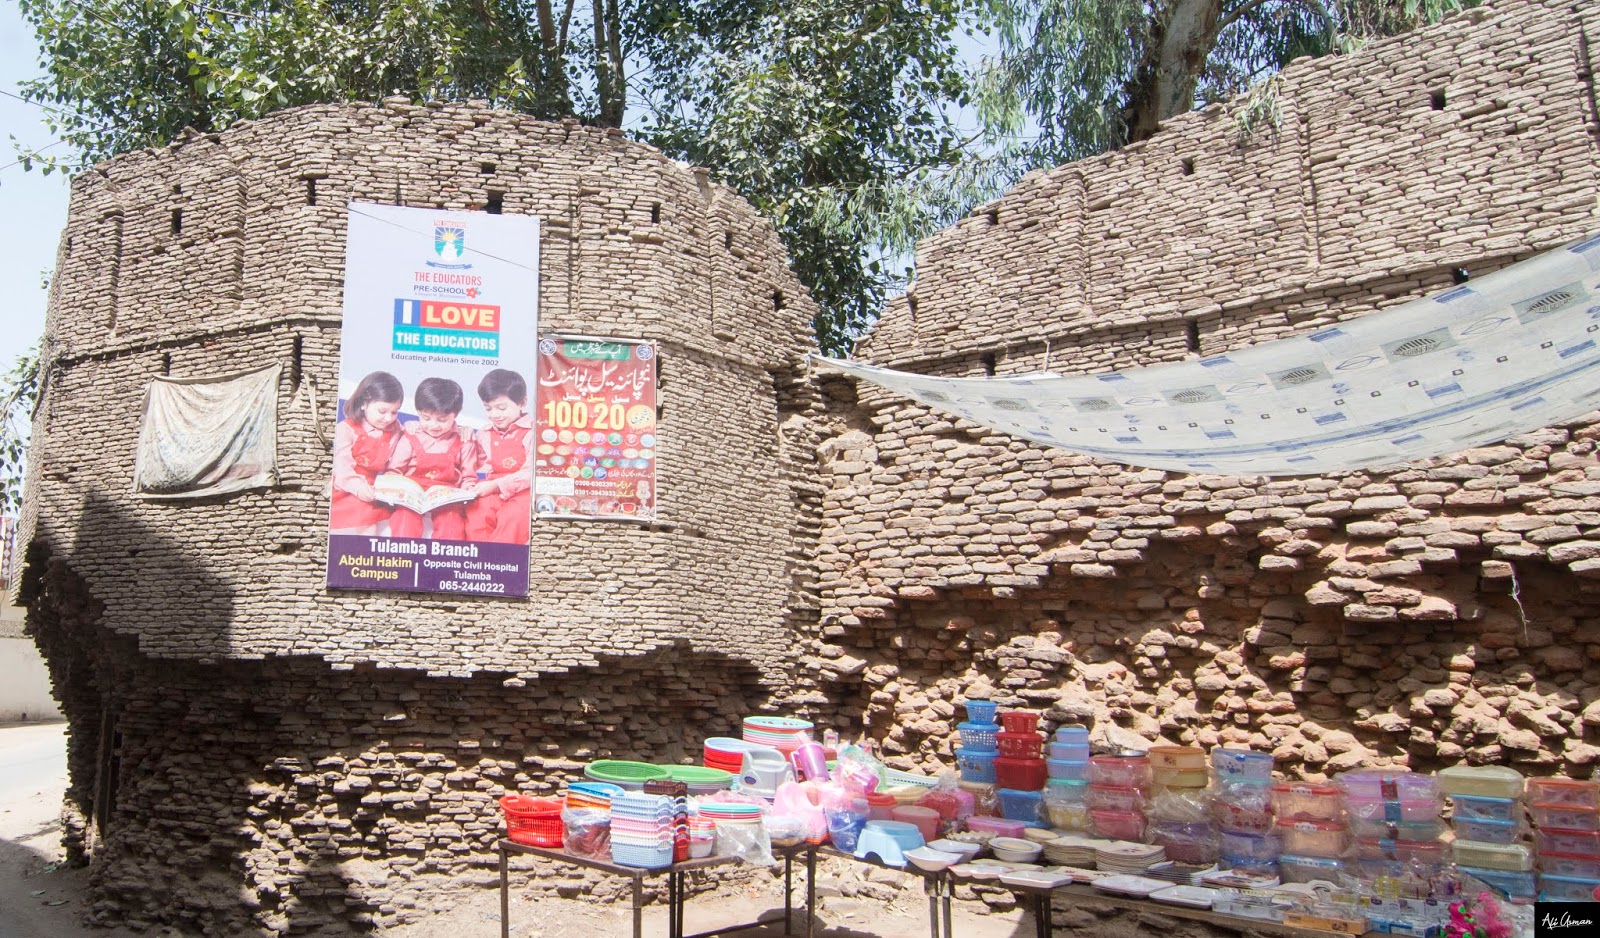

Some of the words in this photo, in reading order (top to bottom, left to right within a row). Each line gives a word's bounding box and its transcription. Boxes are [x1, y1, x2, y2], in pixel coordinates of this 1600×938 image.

[415, 271, 431, 282] THE
[433, 273, 482, 286] EDUCATORS
[413, 284, 466, 295] PRE-SCHOOL
[402, 300, 413, 324] I
[426, 305, 495, 327] LOVE
[396, 332, 419, 343] THE
[424, 333, 497, 350] EDUCATORS
[391, 353, 427, 362] Educating
[428, 355, 459, 364] Pakistan
[460, 357, 479, 365] Since
[481, 358, 499, 366] 2002
[539, 366, 588, 396] پوائنٹ
[588, 362, 618, 393] سیل
[544, 400, 588, 429] 100
[593, 403, 625, 430] 20
[369, 538, 427, 555] Tulamba
[431, 542, 479, 557] Branch
[338, 555, 374, 566] Abdul
[376, 556, 412, 568] Hakim
[423, 559, 461, 569] Opposite
[463, 560, 482, 570] Civil
[484, 561, 519, 572] Hospital
[351, 567, 398, 580] Campus
[453, 571, 492, 580] Tulamba
[439, 581, 505, 593] 065-2440222
